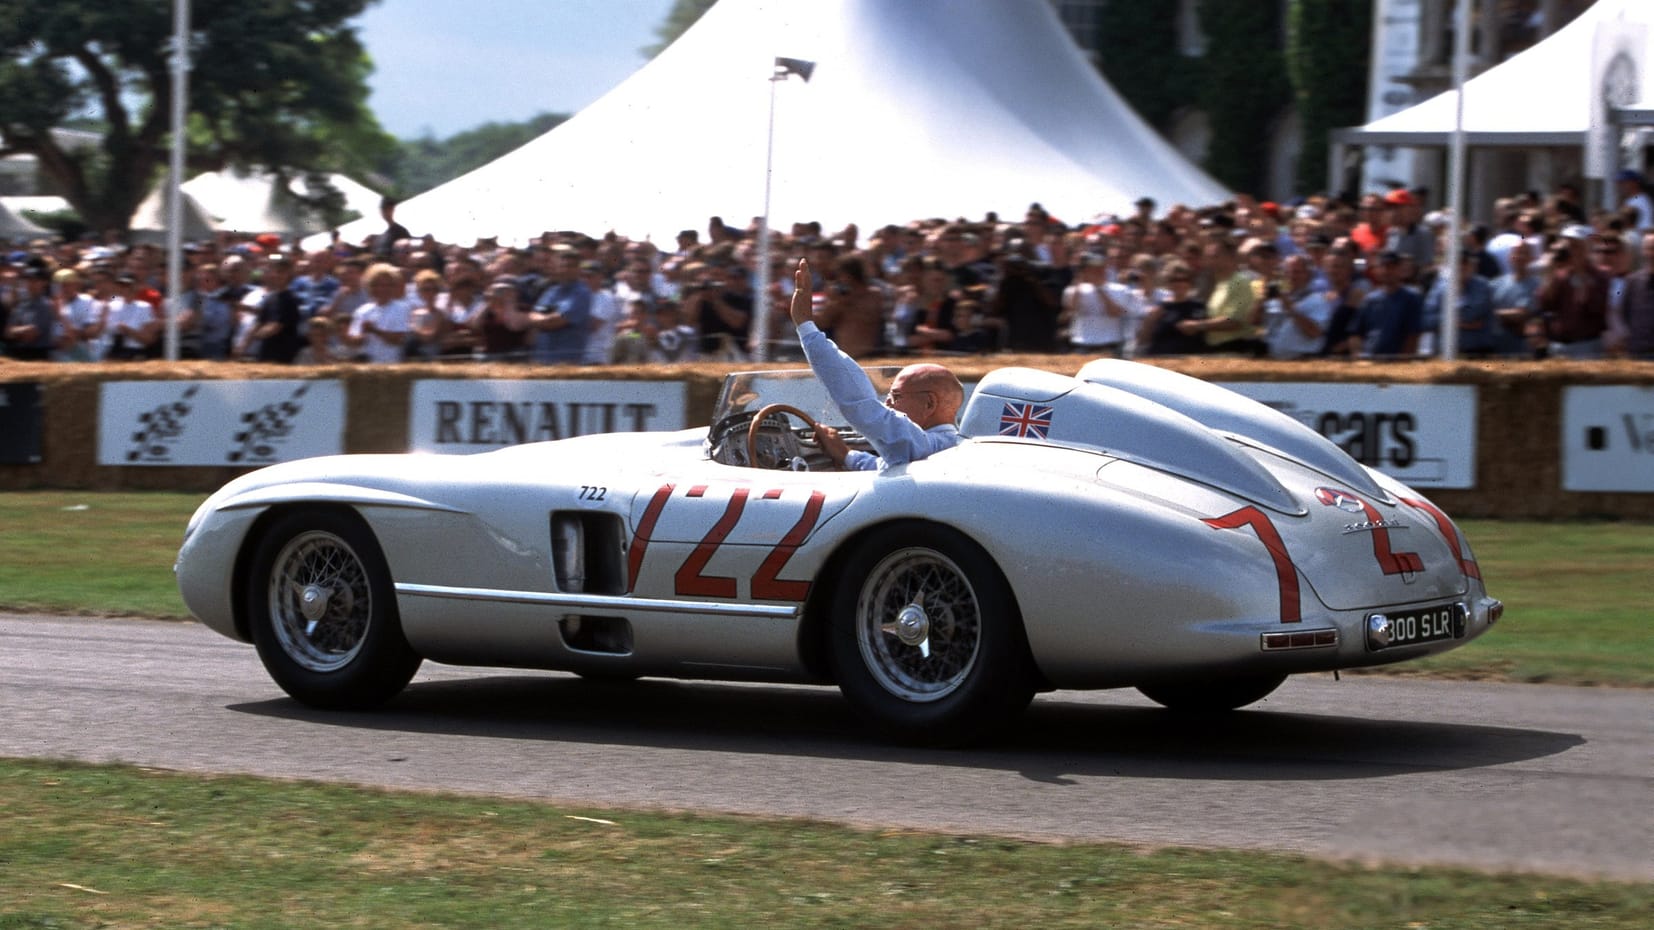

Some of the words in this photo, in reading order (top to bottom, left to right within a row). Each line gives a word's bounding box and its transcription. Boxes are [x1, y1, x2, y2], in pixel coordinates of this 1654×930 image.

[579, 486, 607, 501] 722
[1387, 616, 1416, 641] 300
[1421, 611, 1450, 637] SLR
